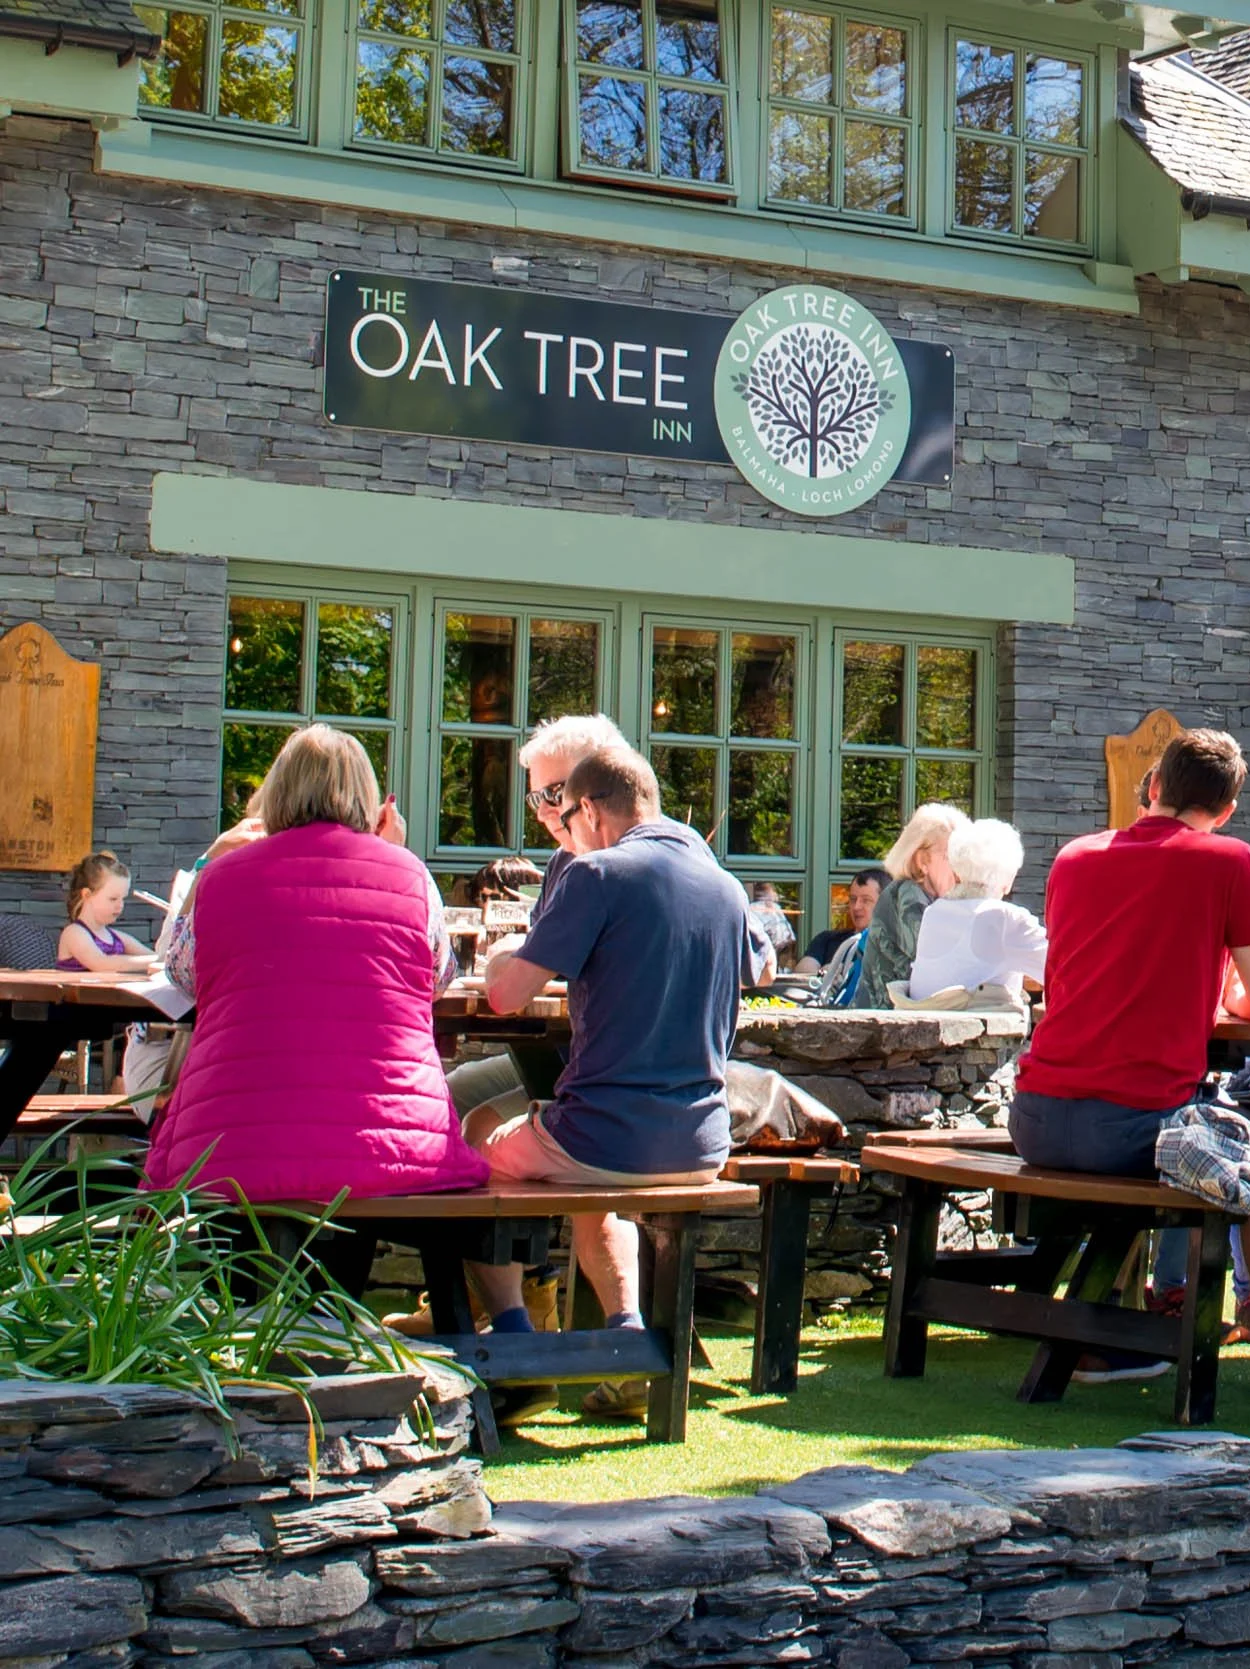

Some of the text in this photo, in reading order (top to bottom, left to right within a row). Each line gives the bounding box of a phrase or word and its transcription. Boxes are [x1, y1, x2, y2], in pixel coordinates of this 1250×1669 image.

[358, 287, 406, 314] THE
[729, 293, 898, 380] OAK TREE INN
[350, 313, 688, 410] OAK TREE
[653, 418, 692, 443] INN
[731, 426, 894, 504] BALMAHA LOCH LOMOND
